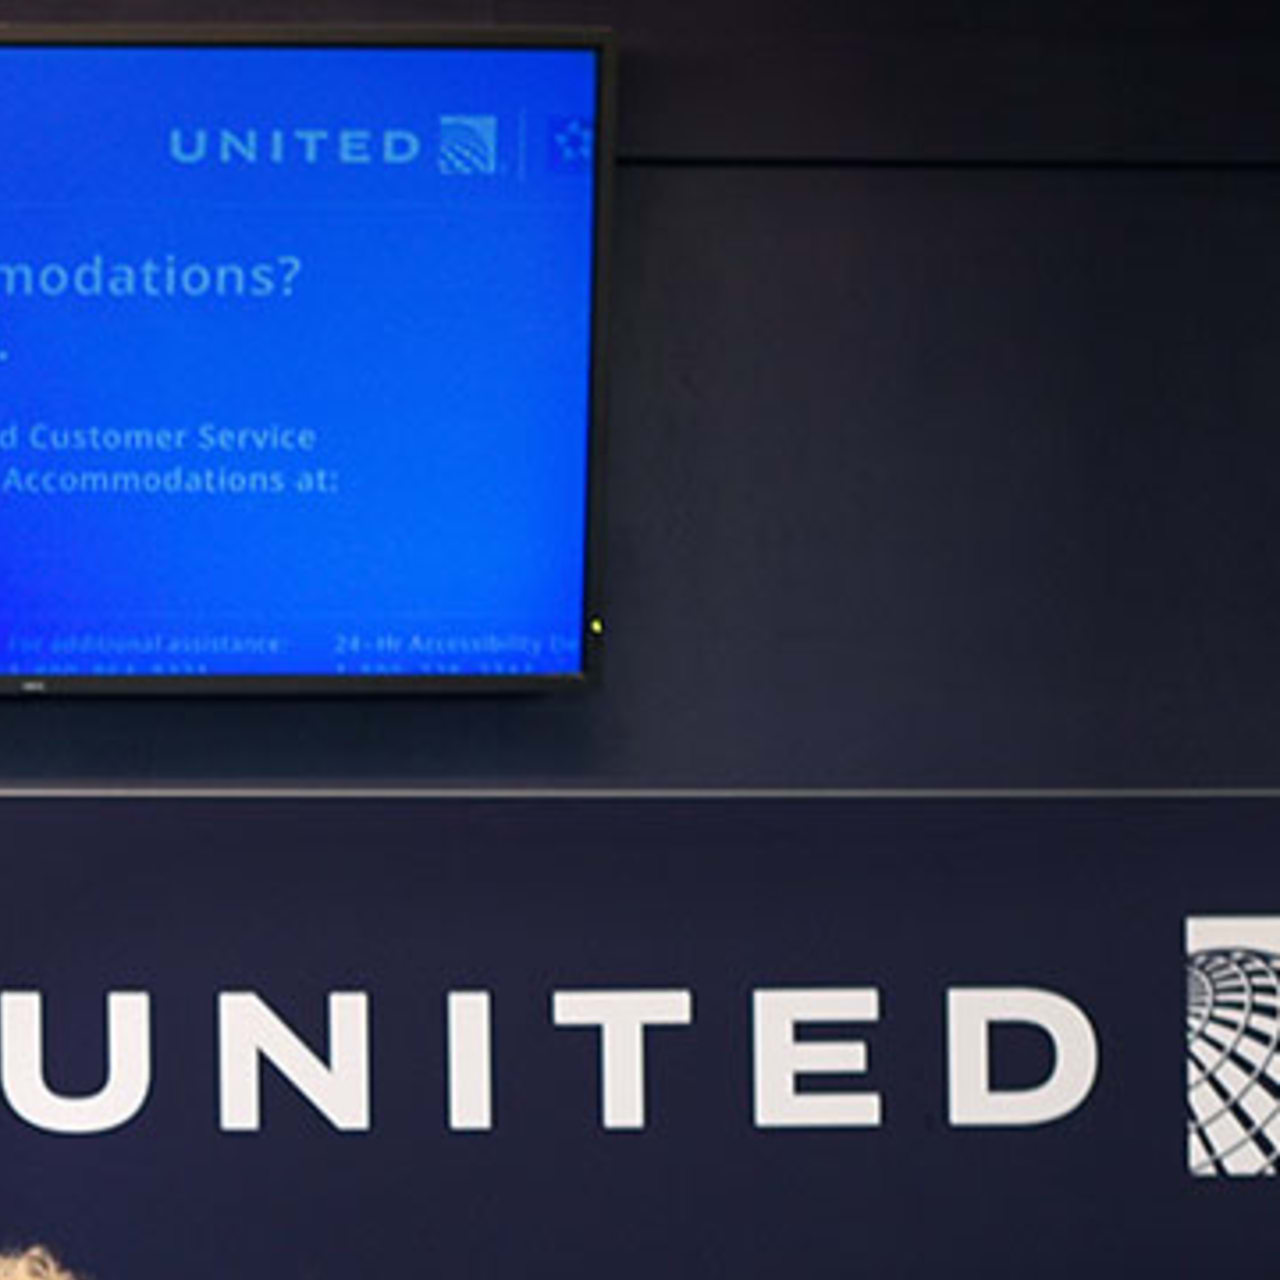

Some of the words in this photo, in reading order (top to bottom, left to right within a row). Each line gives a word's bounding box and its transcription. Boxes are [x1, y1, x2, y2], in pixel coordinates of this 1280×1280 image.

[170, 129, 421, 164] UNITED
[29, 424, 186, 451] Customer
[198, 424, 317, 451] Service
[2, 465, 285, 495] Accommodations
[296, 469, 339, 495] at:
